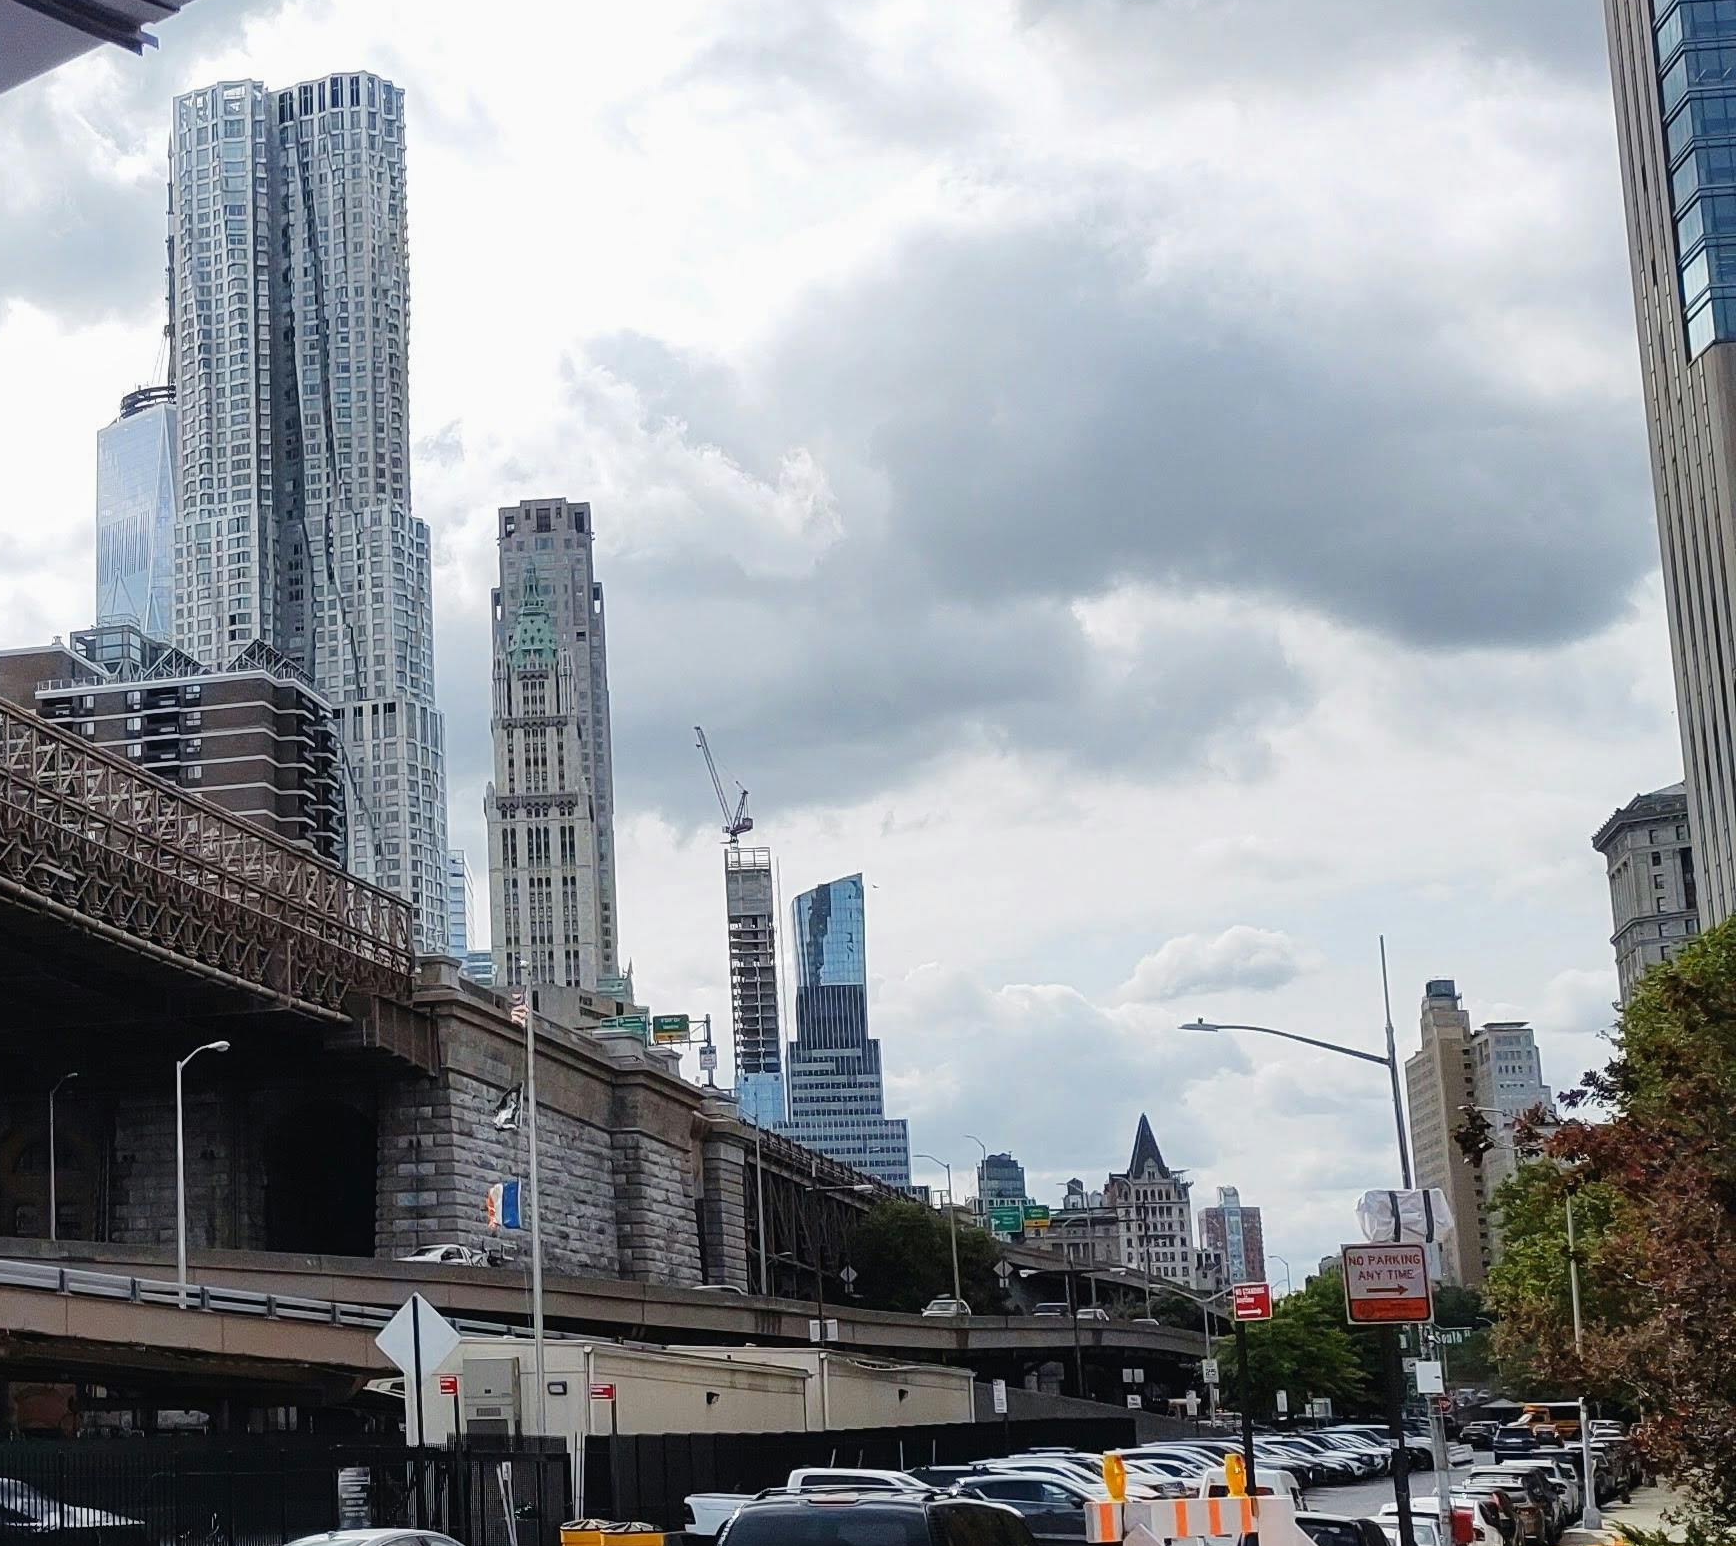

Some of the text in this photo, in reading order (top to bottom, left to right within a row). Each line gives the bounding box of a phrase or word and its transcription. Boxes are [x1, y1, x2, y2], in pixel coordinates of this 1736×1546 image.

[1348, 1254, 1421, 1266] NO PARKING
[1358, 1269, 1415, 1281] ANY TIME
